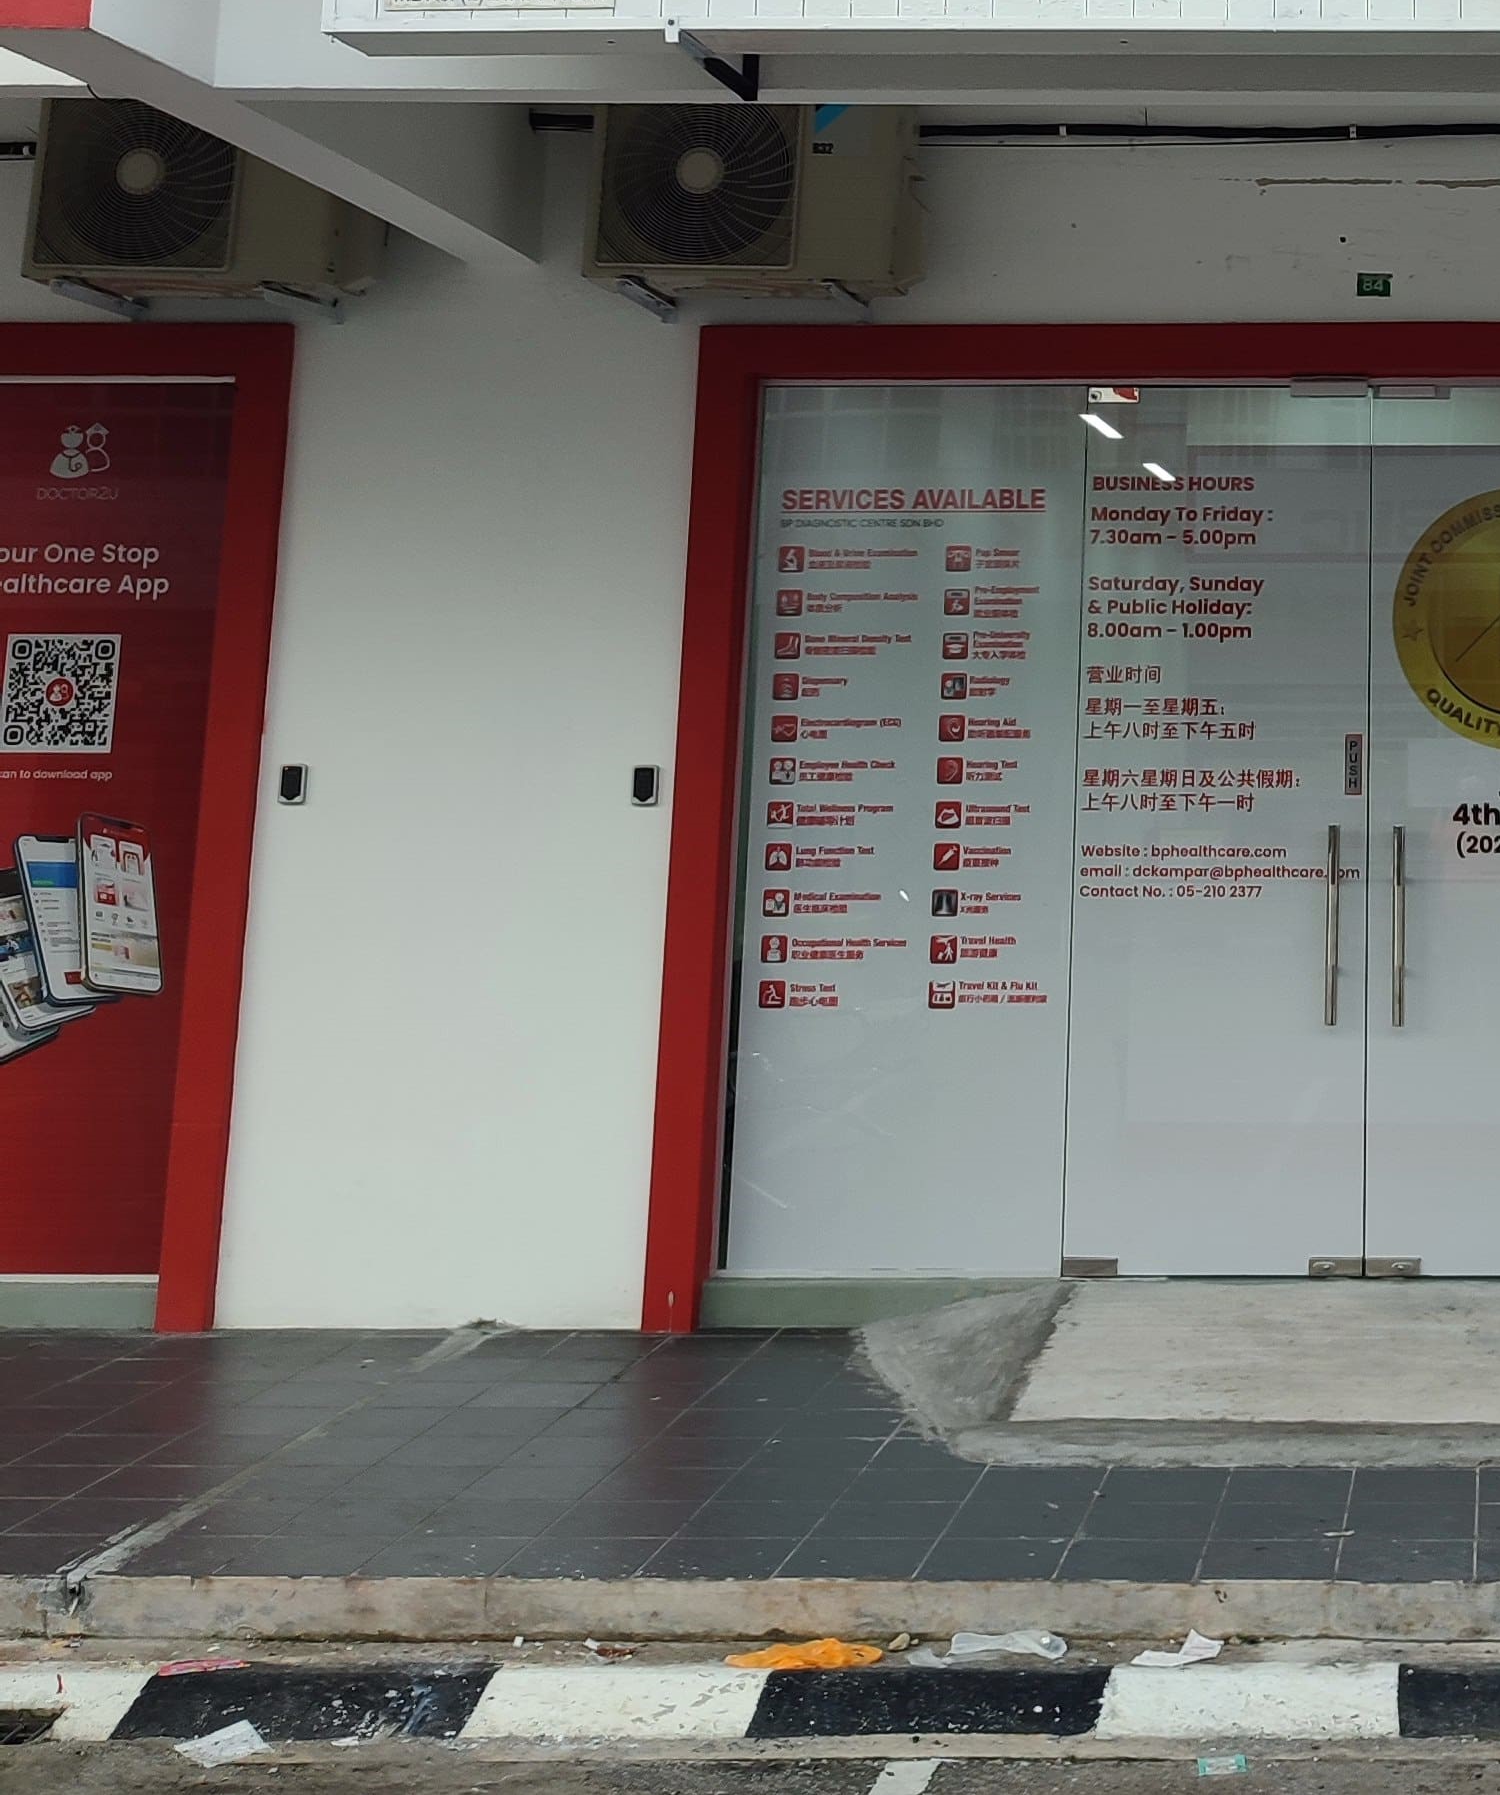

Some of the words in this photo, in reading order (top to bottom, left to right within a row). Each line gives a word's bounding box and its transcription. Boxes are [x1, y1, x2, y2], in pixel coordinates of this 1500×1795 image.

[1362, 278, 1385, 292] 84
[1093, 476, 1184, 492] BUSINESS
[1188, 476, 1255, 492] HOURS
[782, 488, 905, 510] SERVICES
[912, 488, 1046, 510] AVAILABLE
[1091, 506, 1171, 526] Monday
[1175, 506, 1198, 522] To
[1203, 505, 1264, 526] Friday
[1090, 529, 1162, 545] 7.30am
[1182, 529, 1257, 550] 5.00pm
[0, 546, 38, 564] our
[44, 543, 96, 564] One
[102, 543, 160, 570] Stop
[0, 573, 111, 594] althcare
[117, 574, 170, 601] App
[1088, 575, 1185, 596] Saturday,
[1189, 575, 1265, 596] Sunday
[1403, 555, 1432, 608] JOINT
[1087, 599, 1101, 615] &
[1107, 598, 1168, 615] Public
[1171, 598, 1253, 620] Holiday:
[1087, 622, 1162, 639] 8.00am
[1182, 622, 1252, 643] 1.00pm
[1086, 664, 1162, 684] 营业时间
[1083, 720, 1256, 741] 上午八时至下午五时
[1348, 739, 1359, 789] PUSH
[20, 769, 31, 779] to
[32, 769, 88, 779] download
[90, 771, 113, 782] app
[1081, 792, 1255, 813] 上午八时至下午一时
[1081, 844, 1140, 858] Website
[1151, 844, 1287, 860] bphealthcare.com
[1079, 864, 1122, 878] email
[1132, 864, 1360, 880] dckampar@bphealthcare.om
[1079, 885, 1139, 898] Contact
[1142, 885, 1166, 898] No.
[1176, 885, 1226, 898] 05-210
[1229, 885, 1262, 898] 2377
